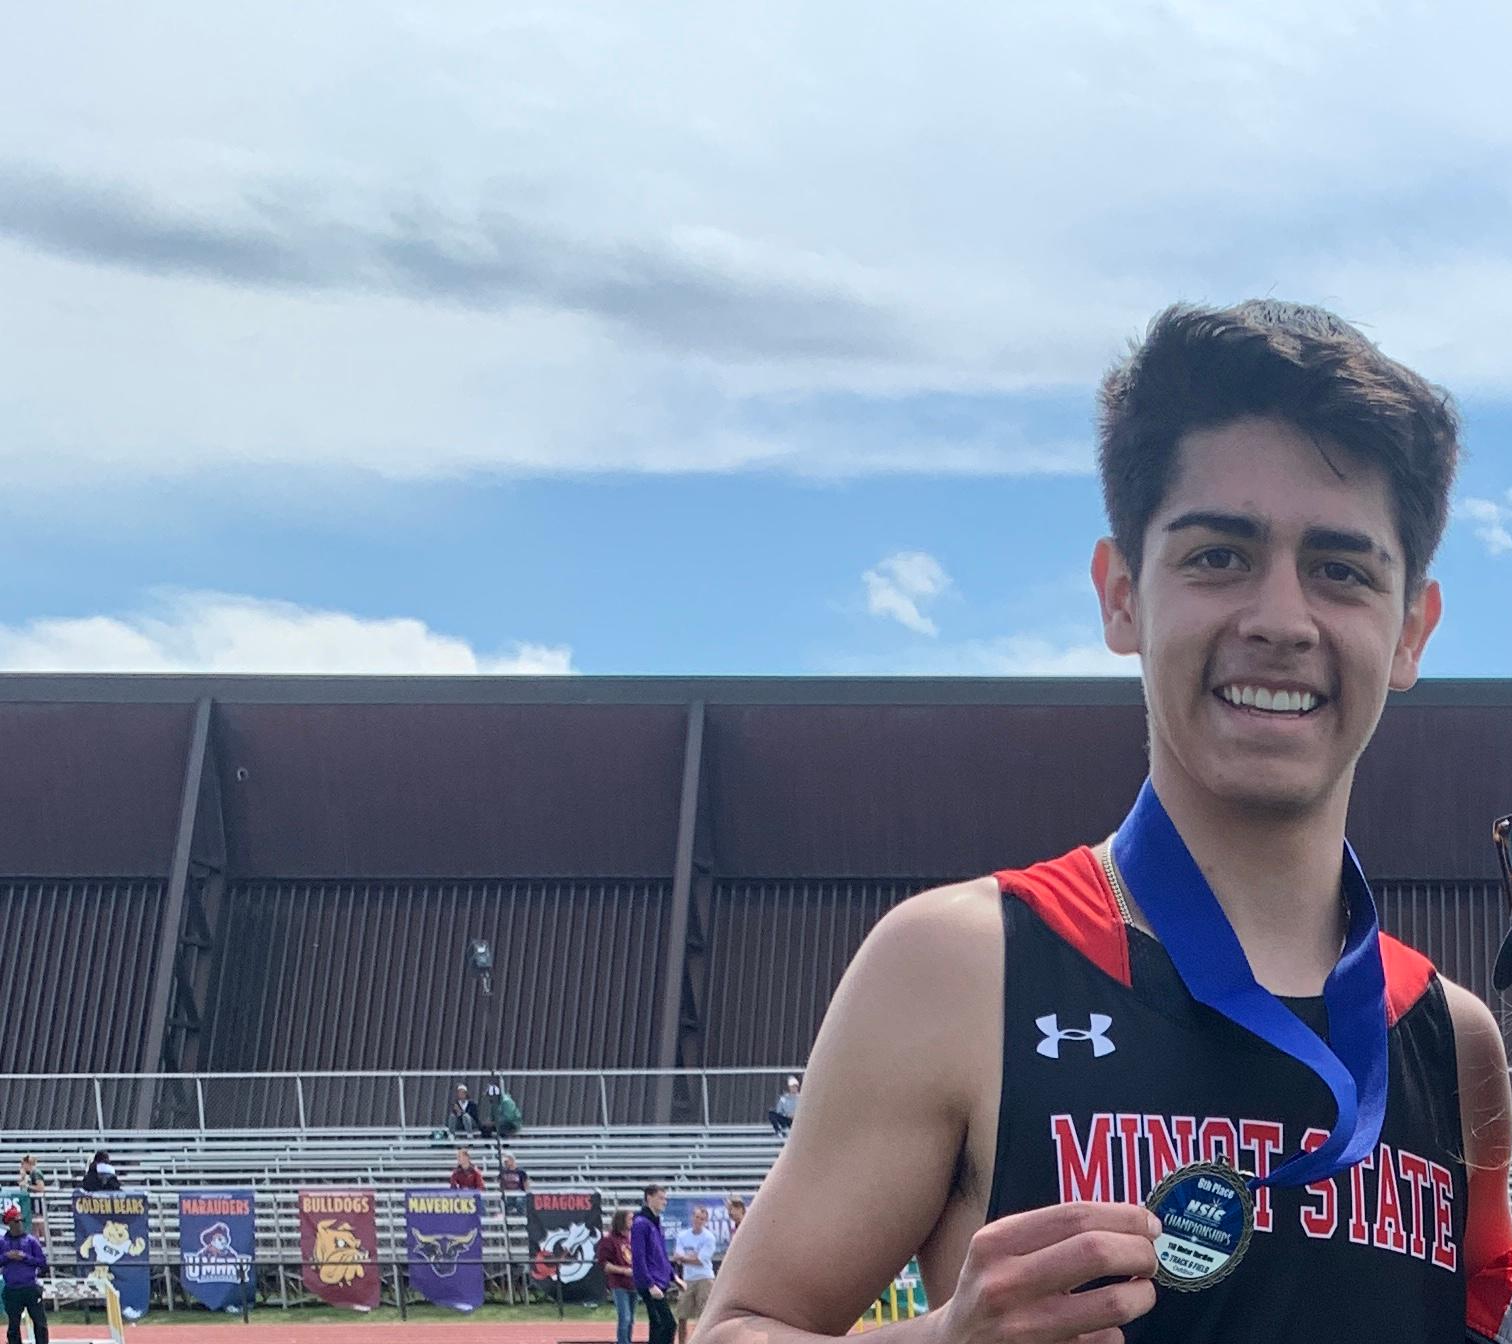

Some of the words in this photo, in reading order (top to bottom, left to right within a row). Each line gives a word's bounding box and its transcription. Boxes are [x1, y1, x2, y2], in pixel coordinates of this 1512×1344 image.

[1050, 1113, 1284, 1233] MINOT
[1300, 1128, 1457, 1273] STATE
[1197, 1177, 1212, 1192] 6th
[1211, 1182, 1235, 1199] Place
[76, 1198, 112, 1214] GOLDEN
[113, 1198, 145, 1214] BEARS
[182, 1199, 249, 1215] MARAUDERS
[303, 1197, 369, 1213] BULLDOGS
[408, 1197, 477, 1214] MAVERICKS
[534, 1194, 592, 1210] DRAGONS
[1164, 1213, 1232, 1245] CHAMPIONSHIPS
[1169, 1254, 1188, 1267] TRACK
[1192, 1262, 1210, 1273] FIELD
